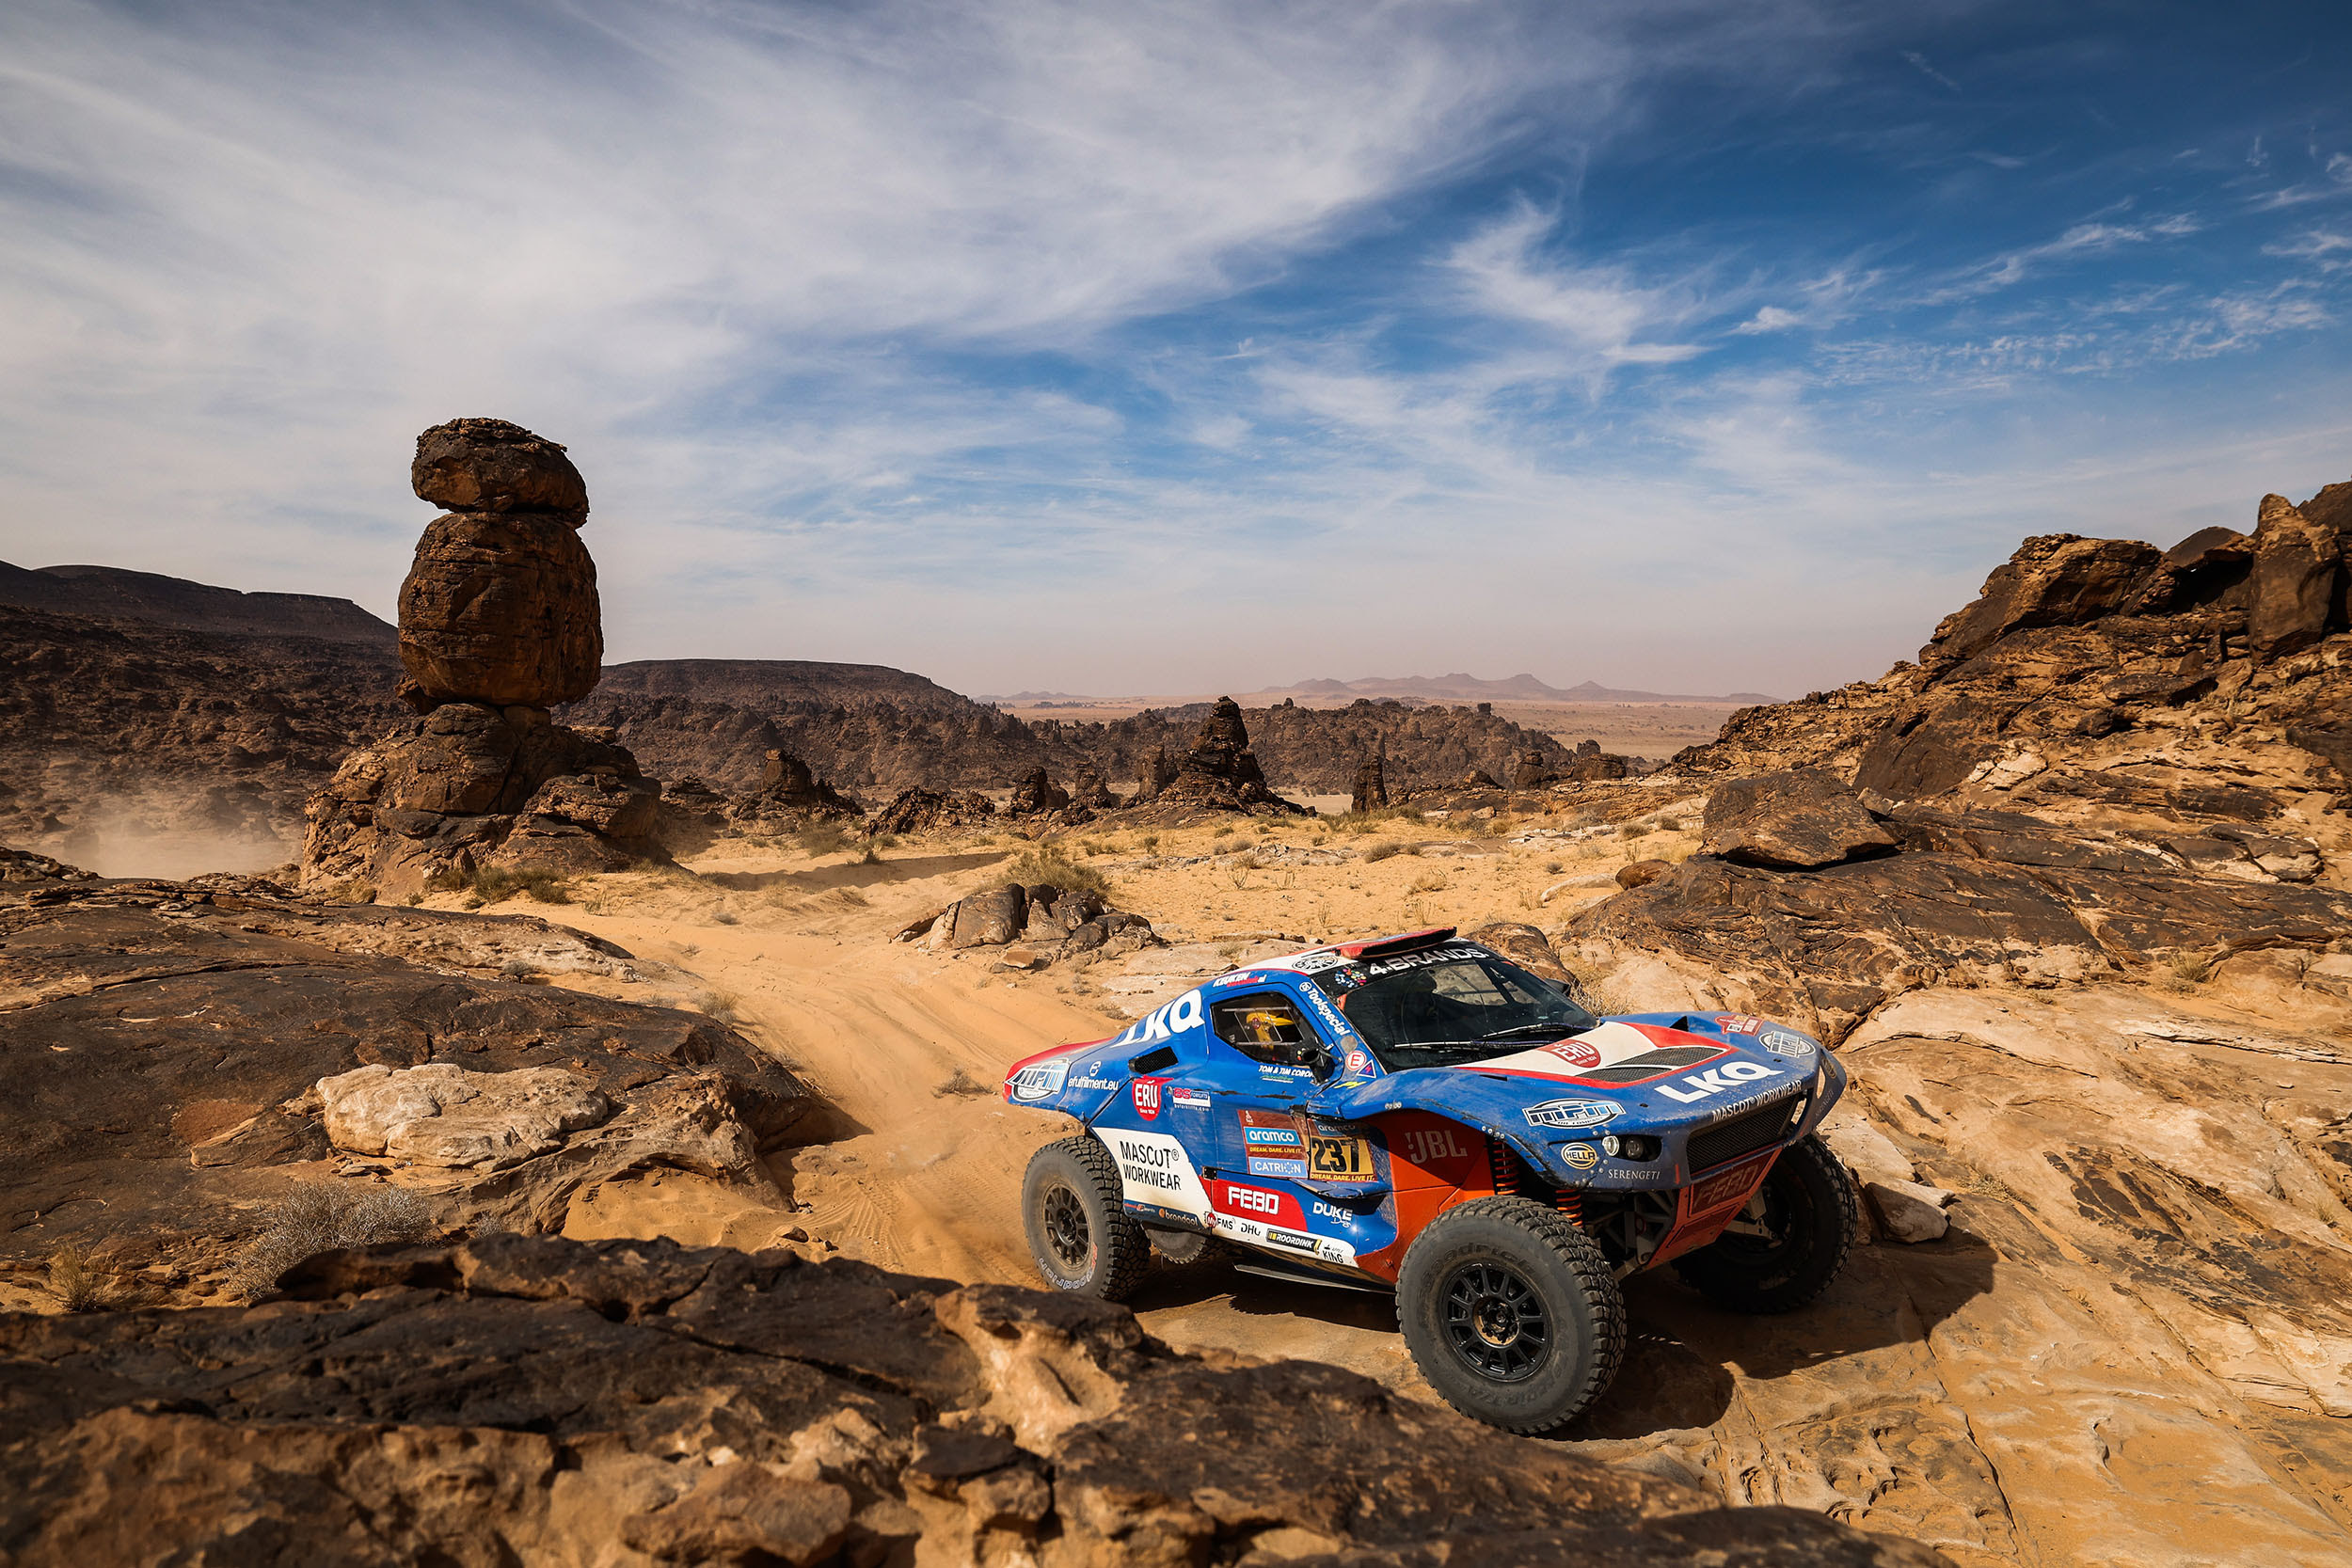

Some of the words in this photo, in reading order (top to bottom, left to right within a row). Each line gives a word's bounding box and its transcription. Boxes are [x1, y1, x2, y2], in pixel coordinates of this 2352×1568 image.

[1110, 989, 1205, 1048] LKQ
[1308, 988, 1351, 1036] Toolspecial
[1258, 1065, 1273, 1073] TOM
[1654, 1061, 1785, 1104] LKQ
[1756, 1079, 1804, 1107] WORKWEAR
[1249, 1130, 1295, 1142] aramco
[1311, 1136, 1359, 1173] 237
[1565, 1151, 1596, 1161] HELLA
[1122, 1164, 1182, 1191] WORKWEAR
[1608, 1169, 1661, 1180] SERENGETI
[1312, 1201, 1353, 1221] DUKE
[1276, 1233, 1314, 1249] ROORDINK
[1322, 1250, 1343, 1264] KING
